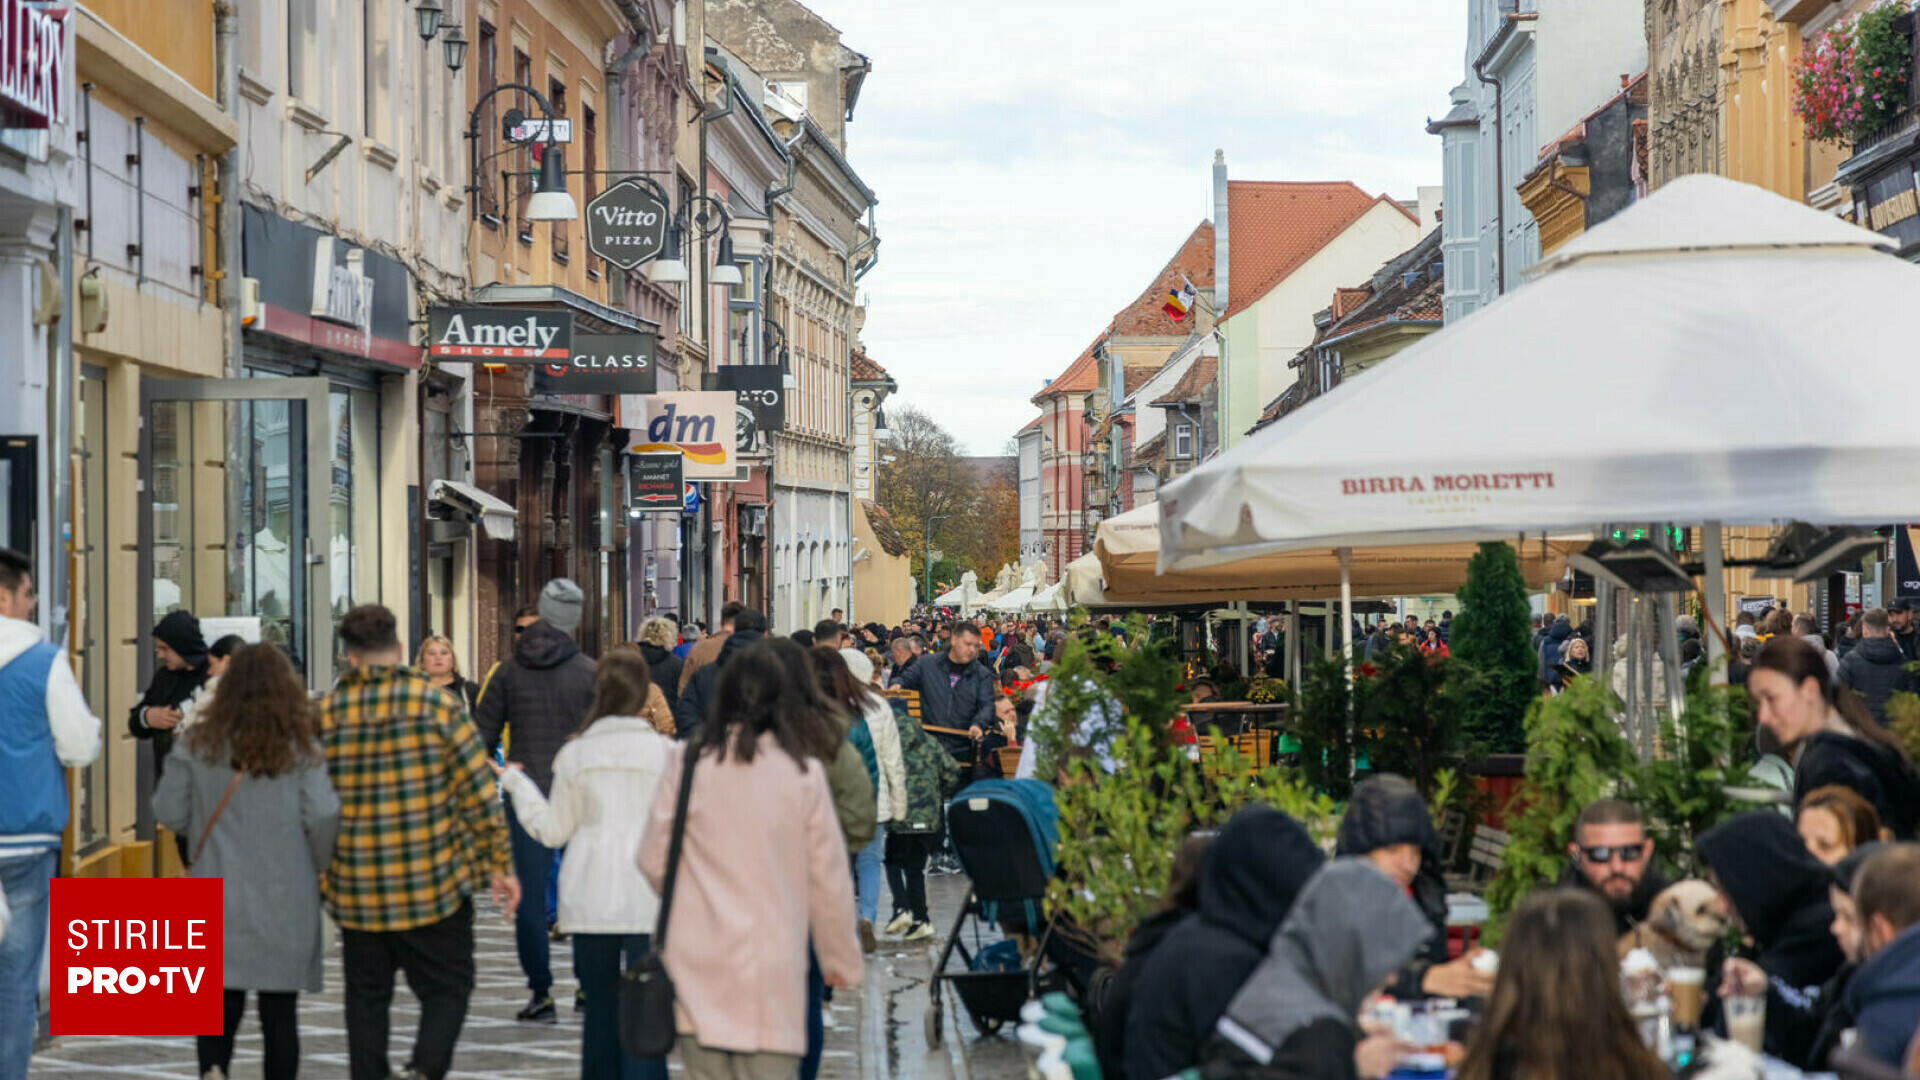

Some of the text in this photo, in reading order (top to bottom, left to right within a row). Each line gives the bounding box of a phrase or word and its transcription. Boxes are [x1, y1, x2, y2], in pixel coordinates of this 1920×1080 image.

[0, 0, 70, 125] LLERY
[595, 206, 657, 226] Vitto
[605, 236, 652, 246] PIZZA
[439, 314, 560, 357] Amely
[440, 347, 538, 357] SHOES
[574, 355, 648, 368] CLASS
[739, 389, 779, 406] ATO
[648, 403, 715, 443] dm
[1341, 471, 1556, 495] BIRRA MORETTI
